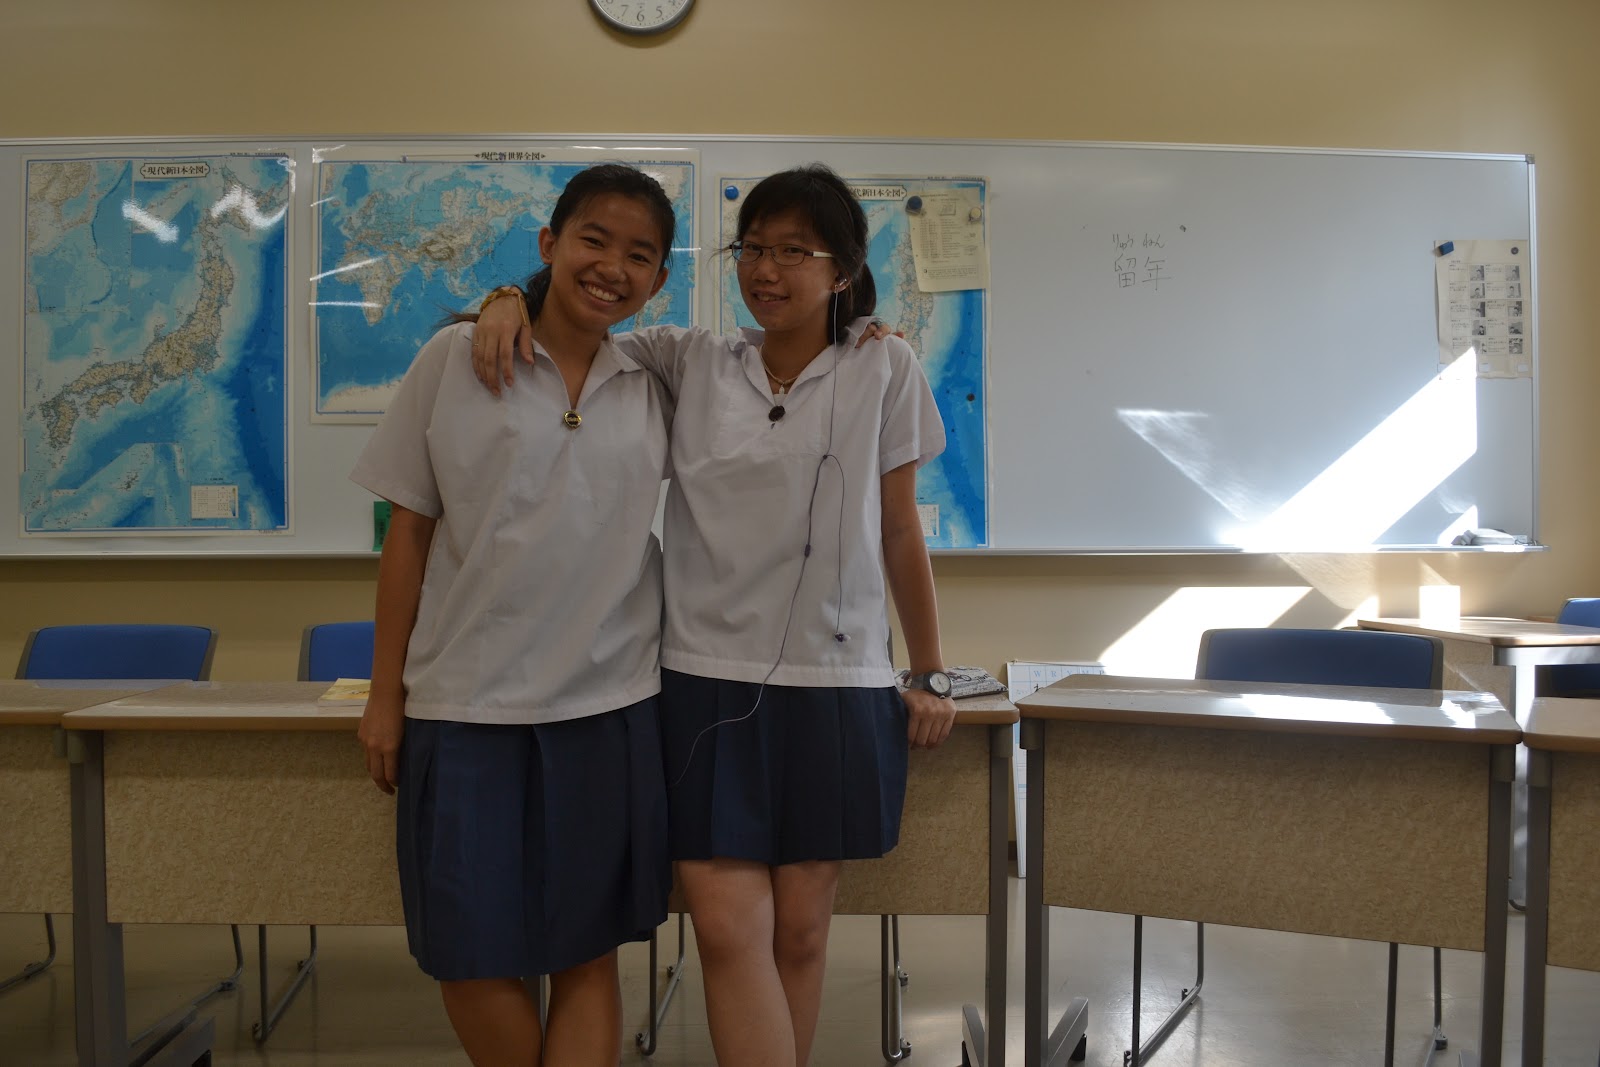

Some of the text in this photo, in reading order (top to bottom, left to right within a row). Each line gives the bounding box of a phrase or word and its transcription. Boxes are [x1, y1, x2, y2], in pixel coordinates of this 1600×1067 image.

[621, 4, 629, 16] 7
[636, 9, 645, 22] 6
[656, 5, 663, 18] 5
[147, 165, 204, 176] 現代新日本全図
[853, 188, 901, 198] 代新日本全図
[1114, 253, 1172, 291] 留年
[1033, 670, 1042, 678] W
[1051, 670, 1057, 678] R
